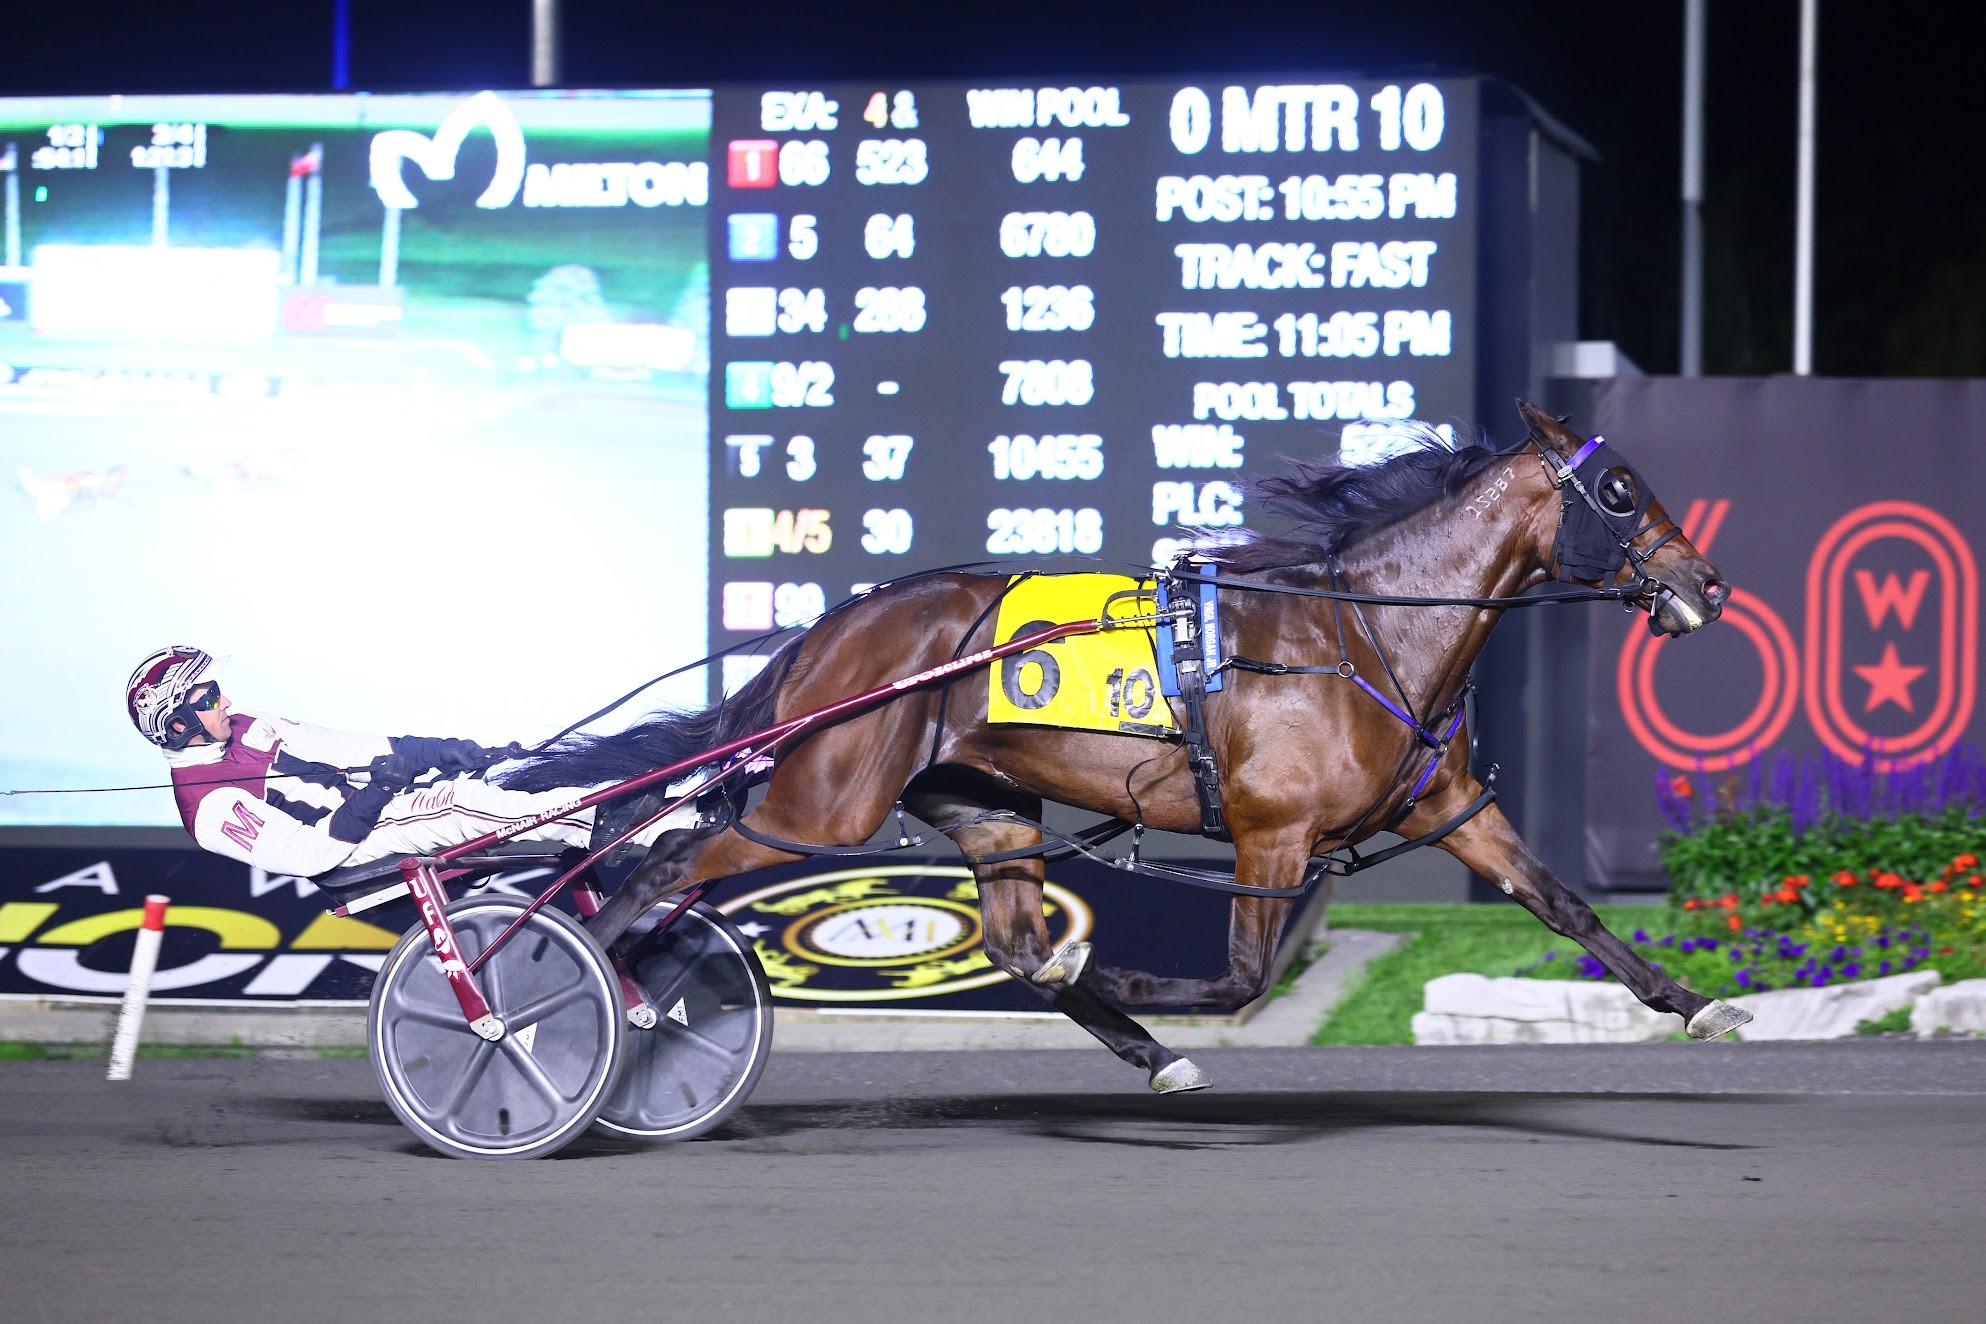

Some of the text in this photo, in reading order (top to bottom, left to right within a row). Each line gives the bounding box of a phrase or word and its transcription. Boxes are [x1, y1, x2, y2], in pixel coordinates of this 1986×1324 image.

[864, 93, 887, 127] 4
[892, 91, 916, 127] &
[967, 87, 1129, 127] WIN POOL
[1170, 83, 1443, 153] 0 MTR 10
[779, 141, 829, 185] 66
[856, 139, 928, 184] 523
[1012, 138, 1084, 182] 644
[523, 162, 708, 206] MILTON
[1156, 173, 1456, 221] POST: 10:55 PM
[789, 215, 817, 259] 5
[865, 214, 914, 258] 64
[1000, 212, 1095, 257] 6780
[1175, 241, 1436, 288] TRACK: FAST
[778, 288, 827, 332] 34
[1001, 286, 1094, 330] 1236
[1156, 310, 1450, 357] TIME: 11:05 PM
[771, 362, 834, 406] 9/2
[1194, 381, 1414, 420] POOL TOTALS
[787, 436, 816, 480] 3
[863, 436, 913, 480] 37
[988, 435, 1103, 479] 10455
[1152, 425, 1244, 467] WIN:
[1153, 481, 1242, 526] PLC:
[774, 509, 832, 554] 4/5
[861, 509, 912, 553] 30
[987, 508, 1102, 553] 23818
[1854, 569, 1931, 631] W
[1203, 600, 1217, 670] VIRGIL MORGAN JR
[933, 649, 993, 677] ECLIPSE
[1001, 619, 1061, 709] 6
[1106, 667, 1155, 719] 10
[220, 800, 265, 852] M
[496, 800, 582, 839] McNAIR RACING
